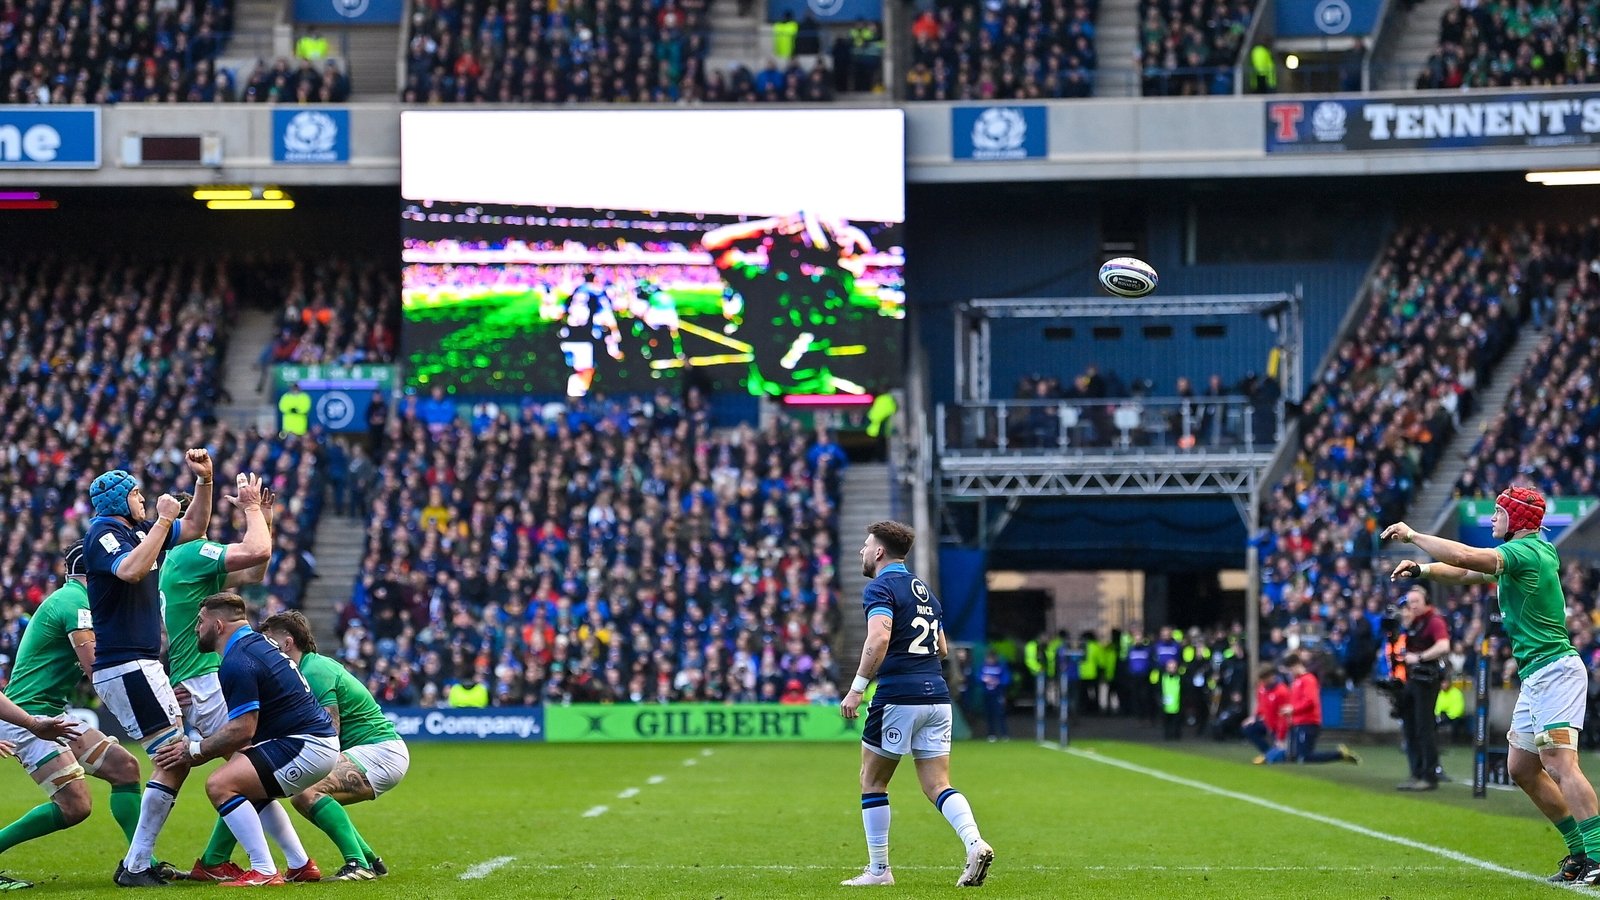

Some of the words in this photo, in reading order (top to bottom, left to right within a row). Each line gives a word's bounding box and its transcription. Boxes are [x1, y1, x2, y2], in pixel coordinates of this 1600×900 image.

[1270, 103, 1304, 142] T
[1363, 98, 1600, 140] TENNENT'S
[908, 616, 939, 655] 21
[425, 711, 540, 739] Company.
[634, 710, 808, 738] GILBERT
